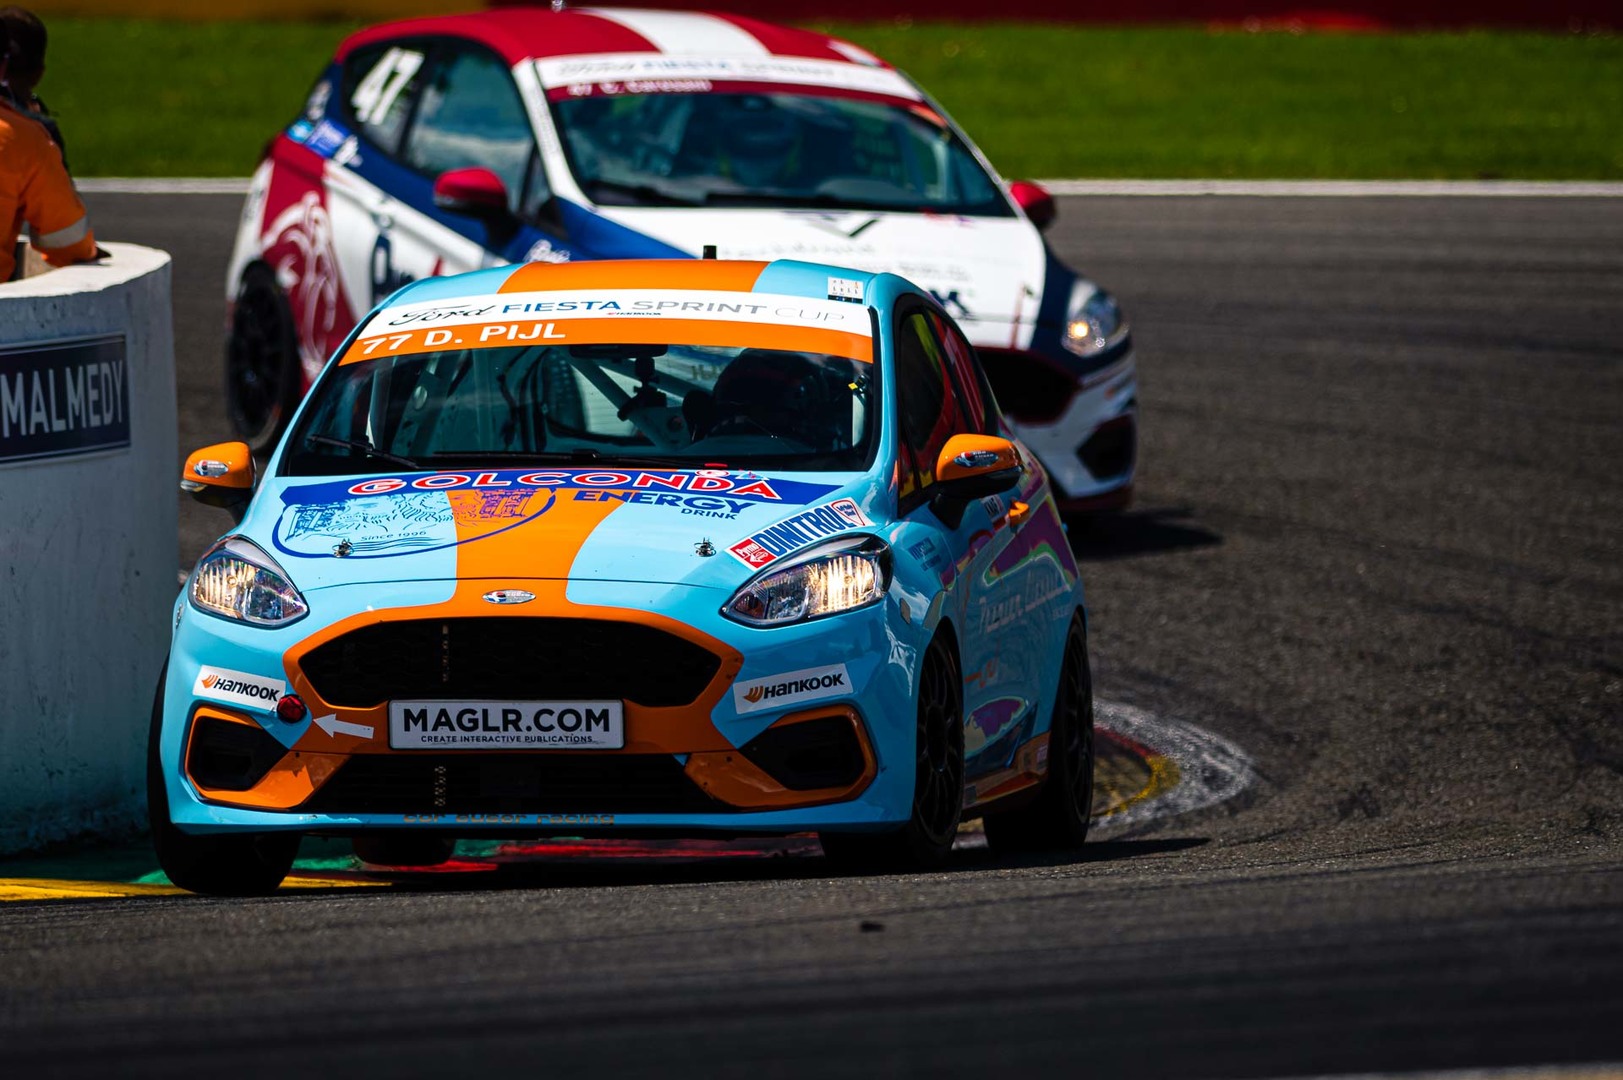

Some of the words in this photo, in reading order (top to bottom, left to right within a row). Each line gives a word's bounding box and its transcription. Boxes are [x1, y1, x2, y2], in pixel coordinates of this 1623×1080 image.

[388, 304, 497, 326] Ford
[502, 300, 621, 314] FIESTA
[631, 300, 768, 314] SPRINT
[775, 307, 845, 322] CUP
[362, 333, 413, 355] 77
[423, 330, 463, 346] D.
[479, 322, 566, 342] PIJL
[0, 360, 123, 438] MALMEDY
[348, 472, 782, 500] GOLCONDA
[573, 490, 756, 513] ENERGY
[681, 508, 738, 520] DRINK
[750, 504, 857, 557] DINITROL
[403, 708, 610, 732] MAGLR.COM
[421, 735, 457, 743] CREATE
[460, 735, 522, 743] INTERACTIVE
[525, 735, 593, 743] PUBLICATIONS
